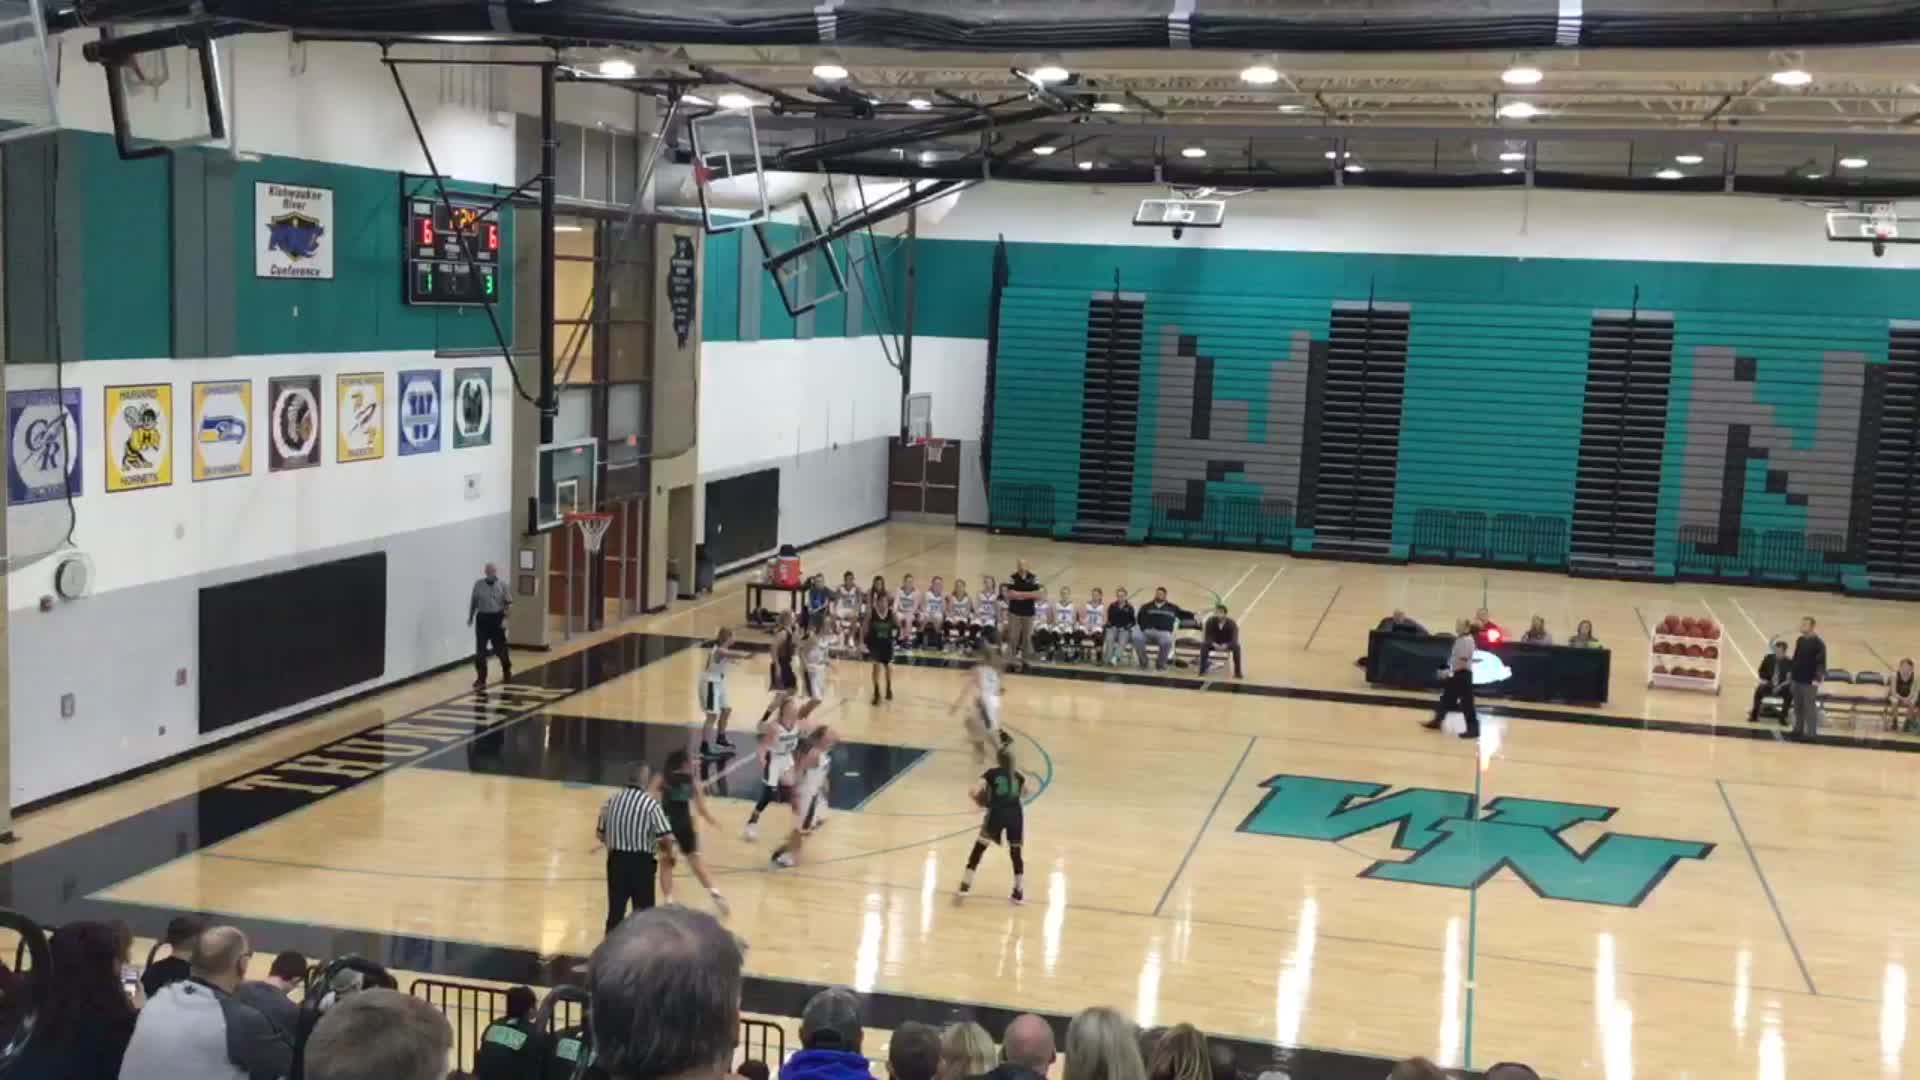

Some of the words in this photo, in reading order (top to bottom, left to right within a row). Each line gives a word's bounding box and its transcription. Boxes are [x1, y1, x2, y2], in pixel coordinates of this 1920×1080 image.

[282, 198, 306, 210] River
[423, 218, 433, 245] 6
[488, 224, 499, 250] 6
[269, 264, 321, 276] Conference
[485, 274, 494, 294] 3
[1677, 346, 1888, 563] N
